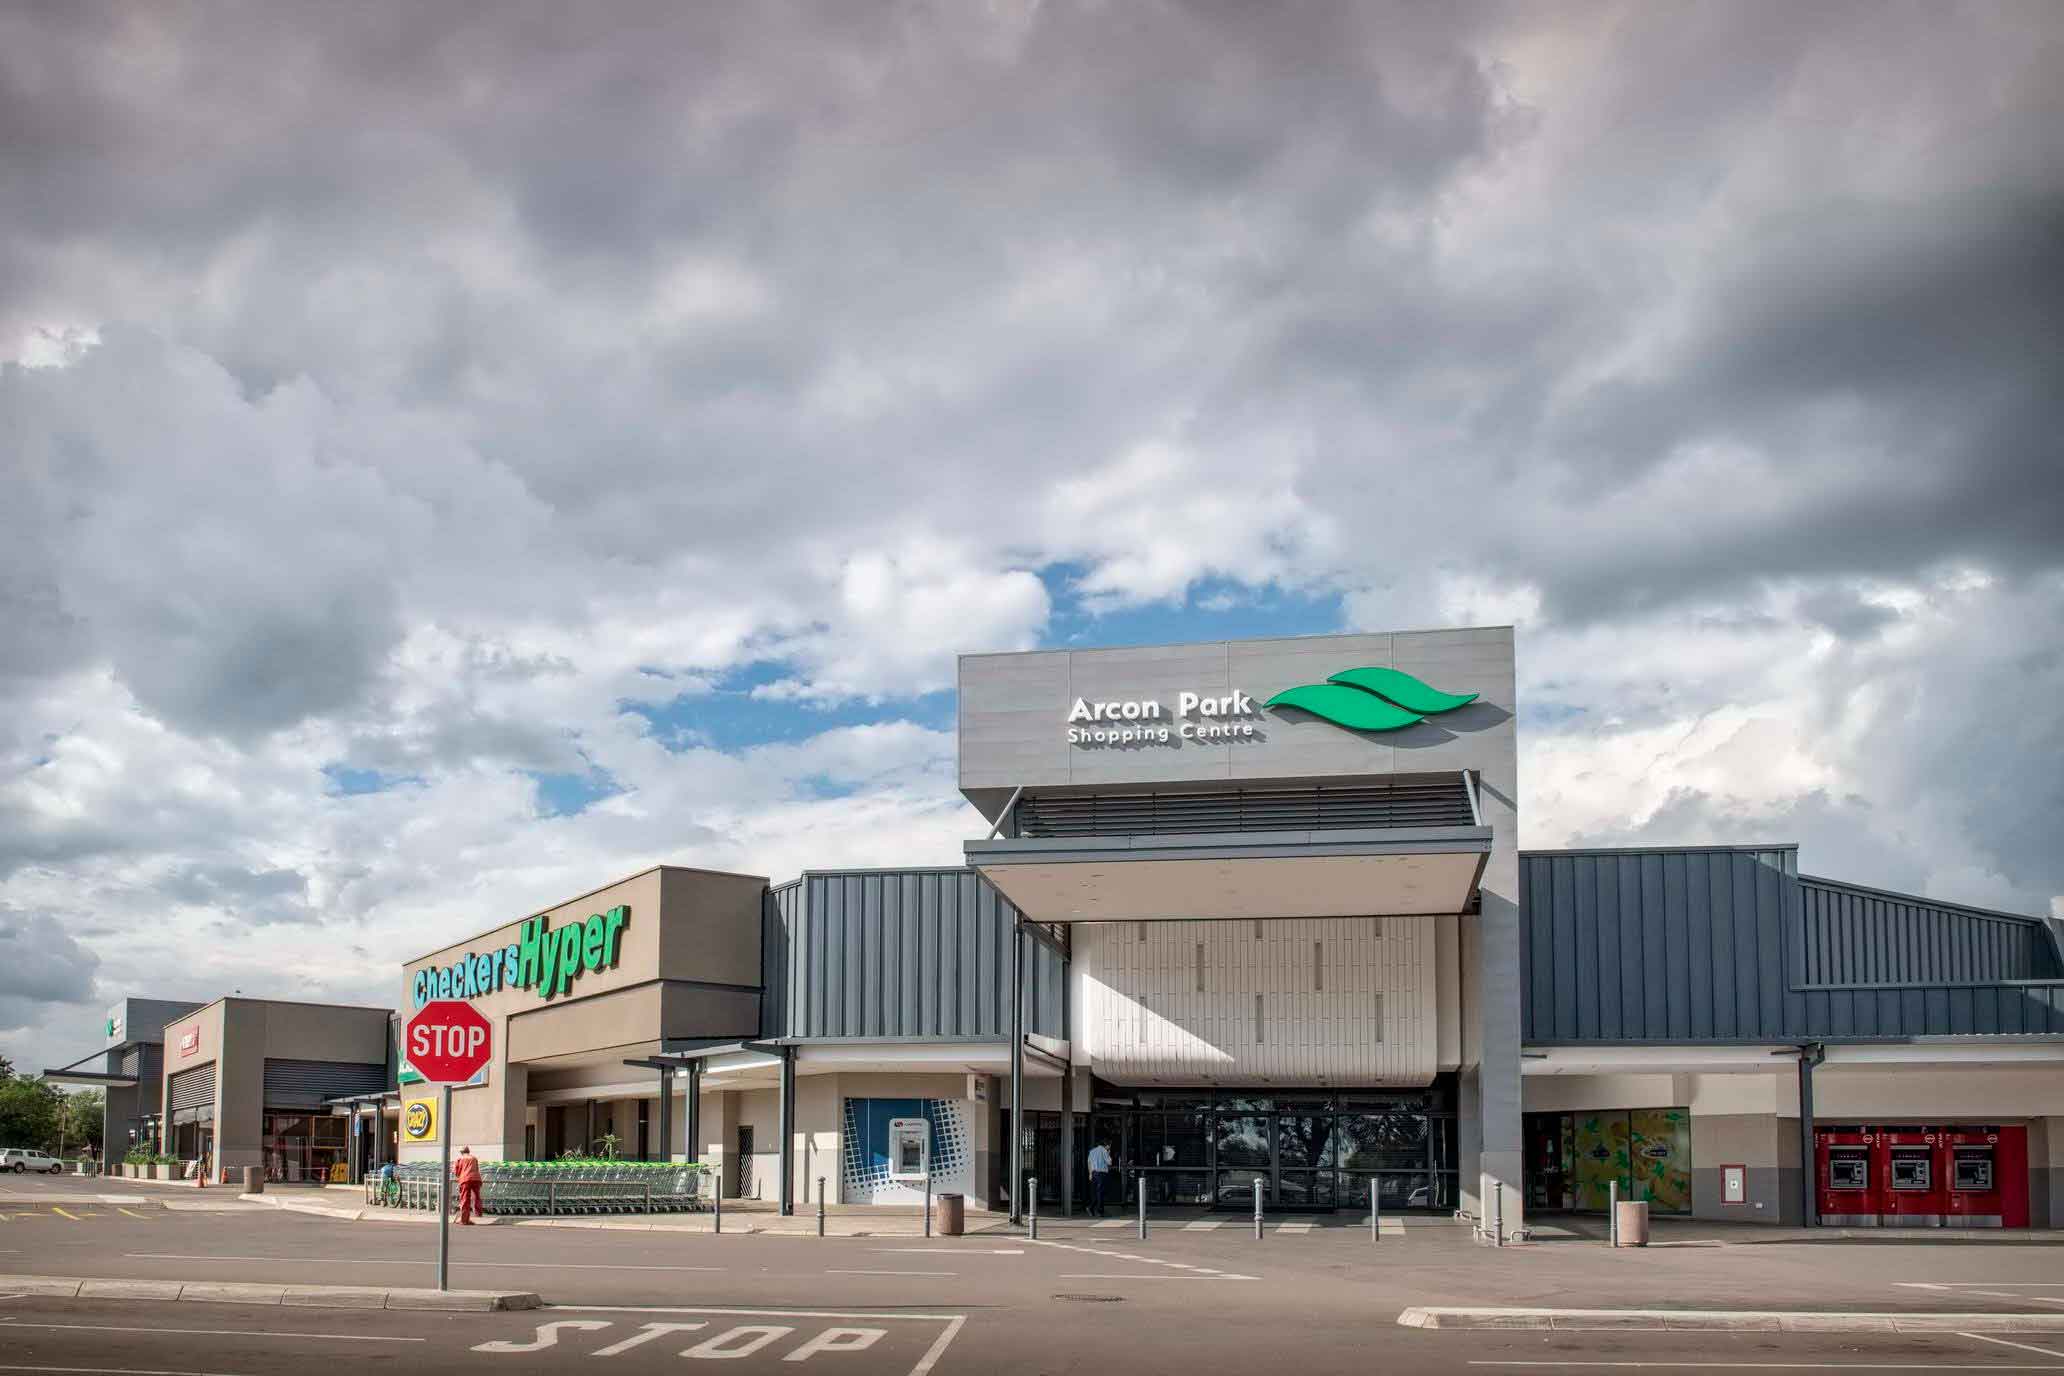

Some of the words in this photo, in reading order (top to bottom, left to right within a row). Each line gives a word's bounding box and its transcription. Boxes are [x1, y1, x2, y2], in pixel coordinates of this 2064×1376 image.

[1068, 697, 1160, 721] Arcon
[1179, 689, 1253, 717] Park
[1067, 725, 1169, 744] Shopping
[1180, 723, 1253, 738] Centre
[412, 1024, 486, 1058] STOP
[470, 1320, 889, 1361] STOP
